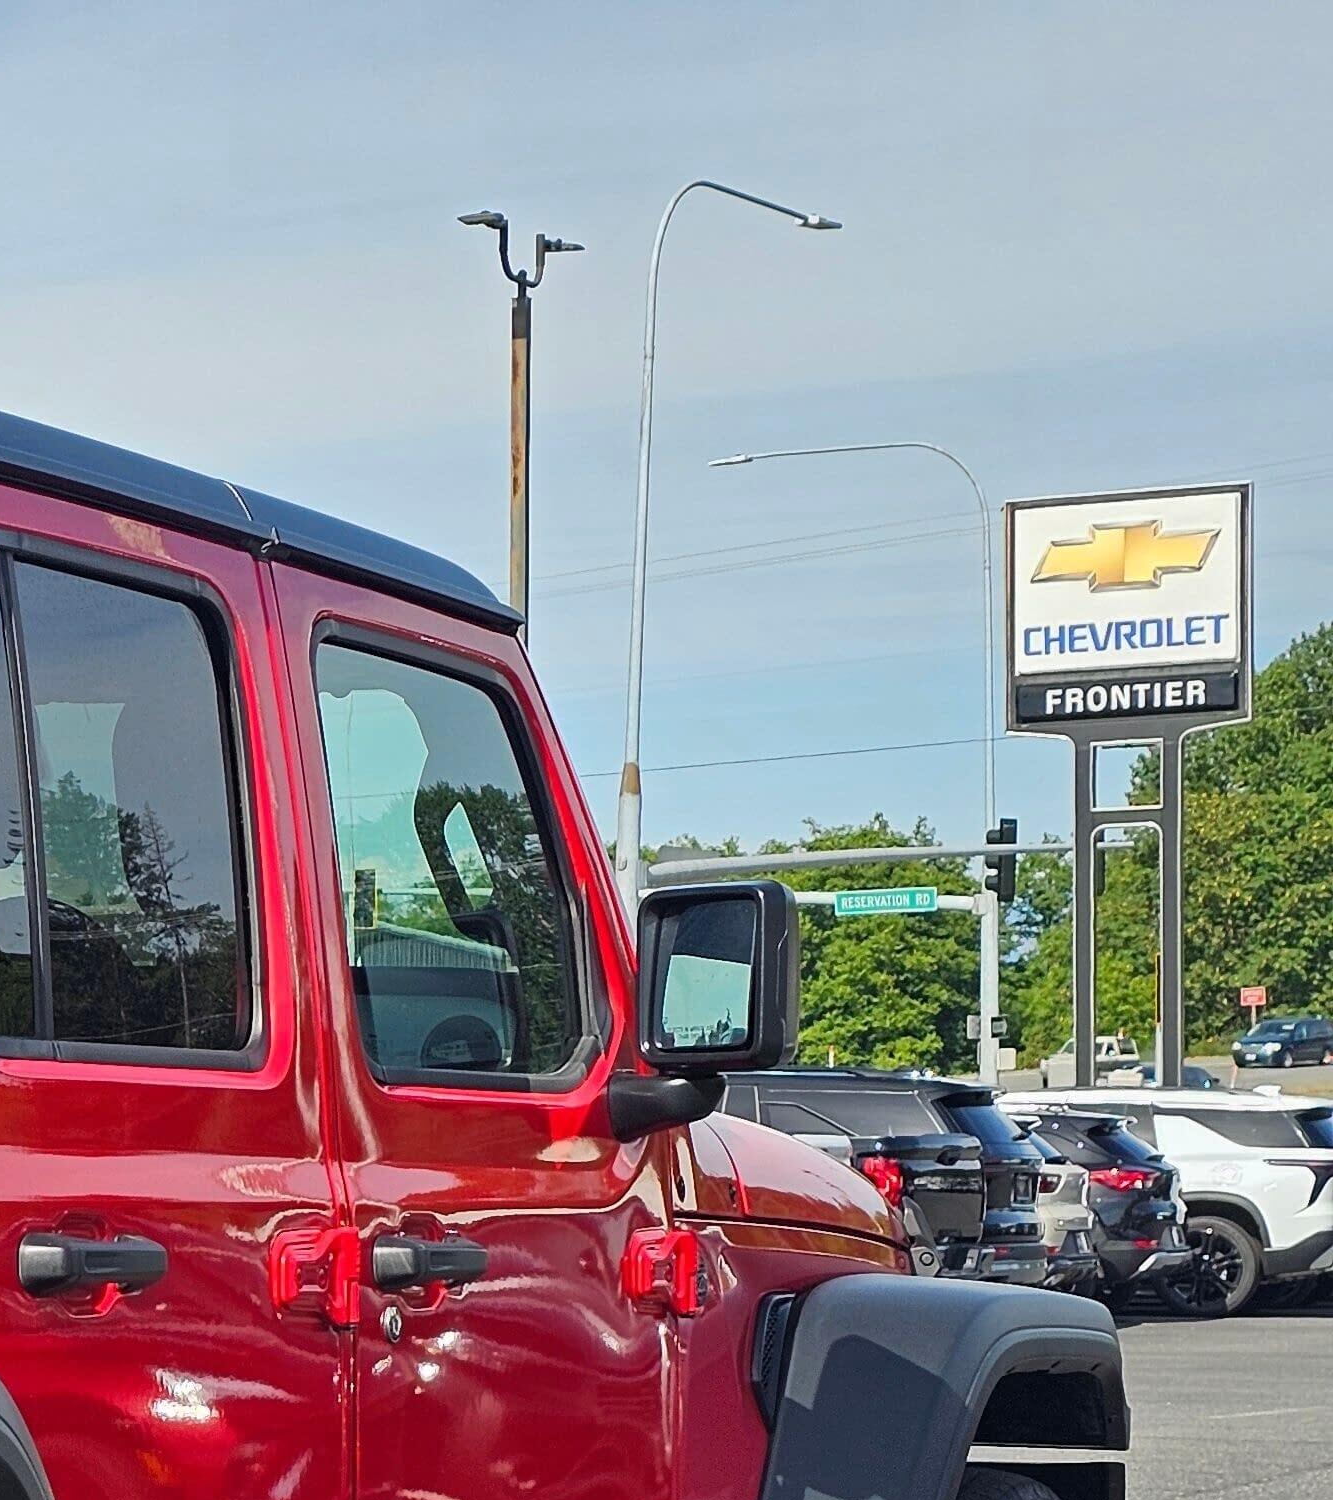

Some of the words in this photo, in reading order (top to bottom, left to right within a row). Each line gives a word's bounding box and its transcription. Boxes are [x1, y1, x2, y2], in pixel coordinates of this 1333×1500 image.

[1023, 613, 1229, 656] CHEVROLET
[1044, 679, 1206, 715] FRONTIER
[841, 893, 910, 909] RESERVATION
[915, 893, 931, 905] RD
